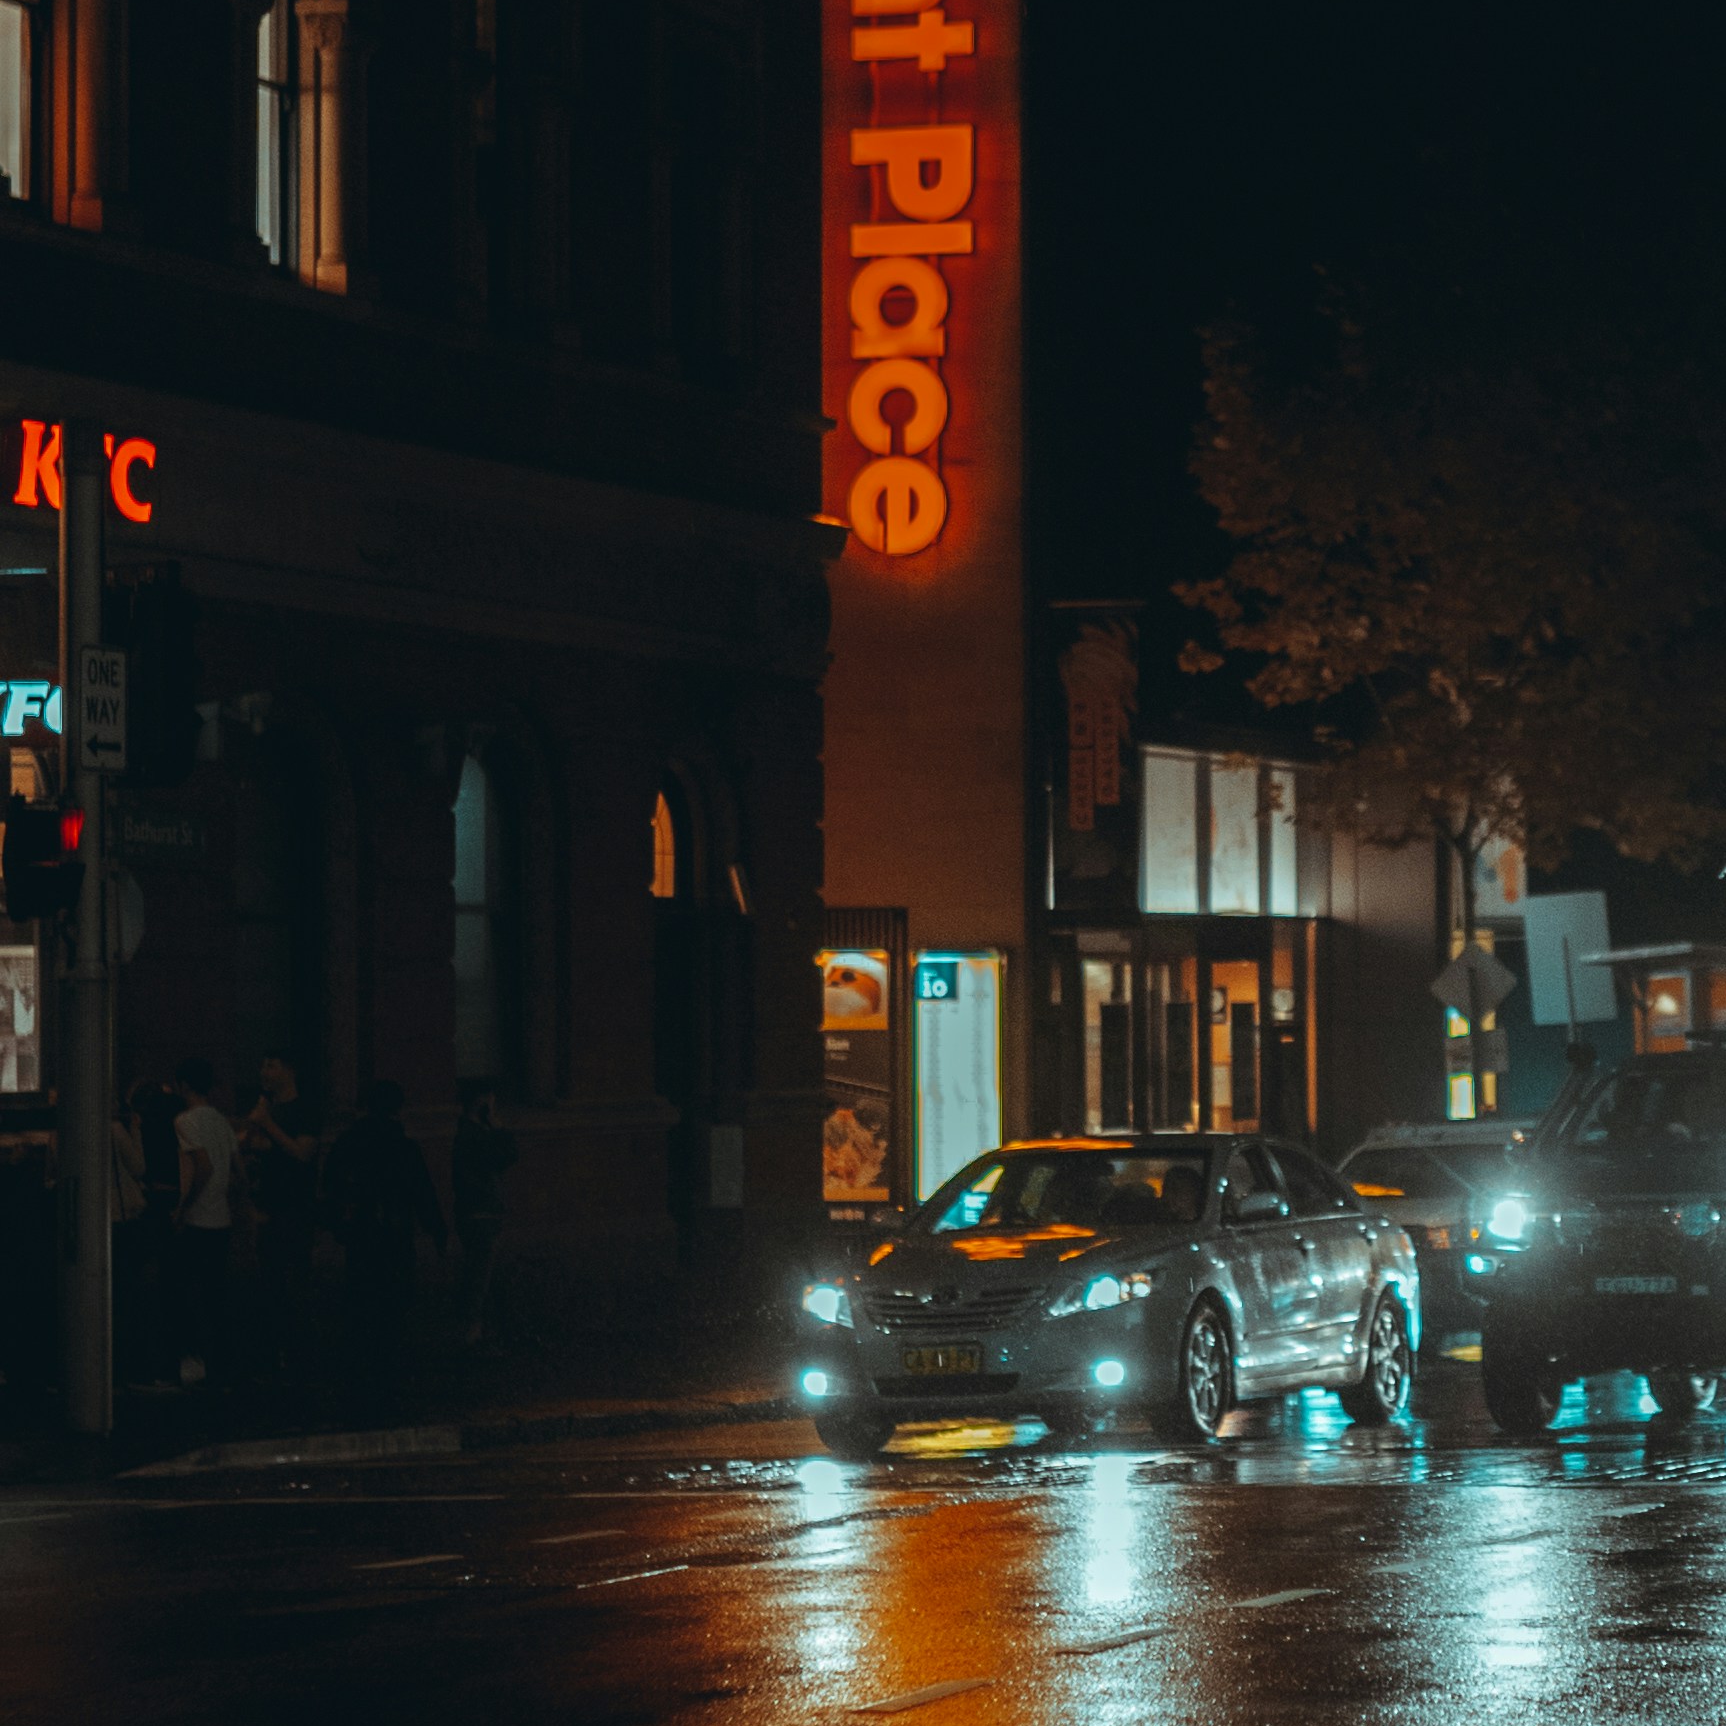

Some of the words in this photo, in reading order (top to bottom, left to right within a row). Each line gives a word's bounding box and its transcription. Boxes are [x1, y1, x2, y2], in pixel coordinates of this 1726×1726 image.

[849, 124, 973, 556] Place
[13, 420, 156, 522] KC
[88, 659, 119, 687] ONE
[86, 696, 119, 724] WAY
[923, 979, 948, 998] 10
